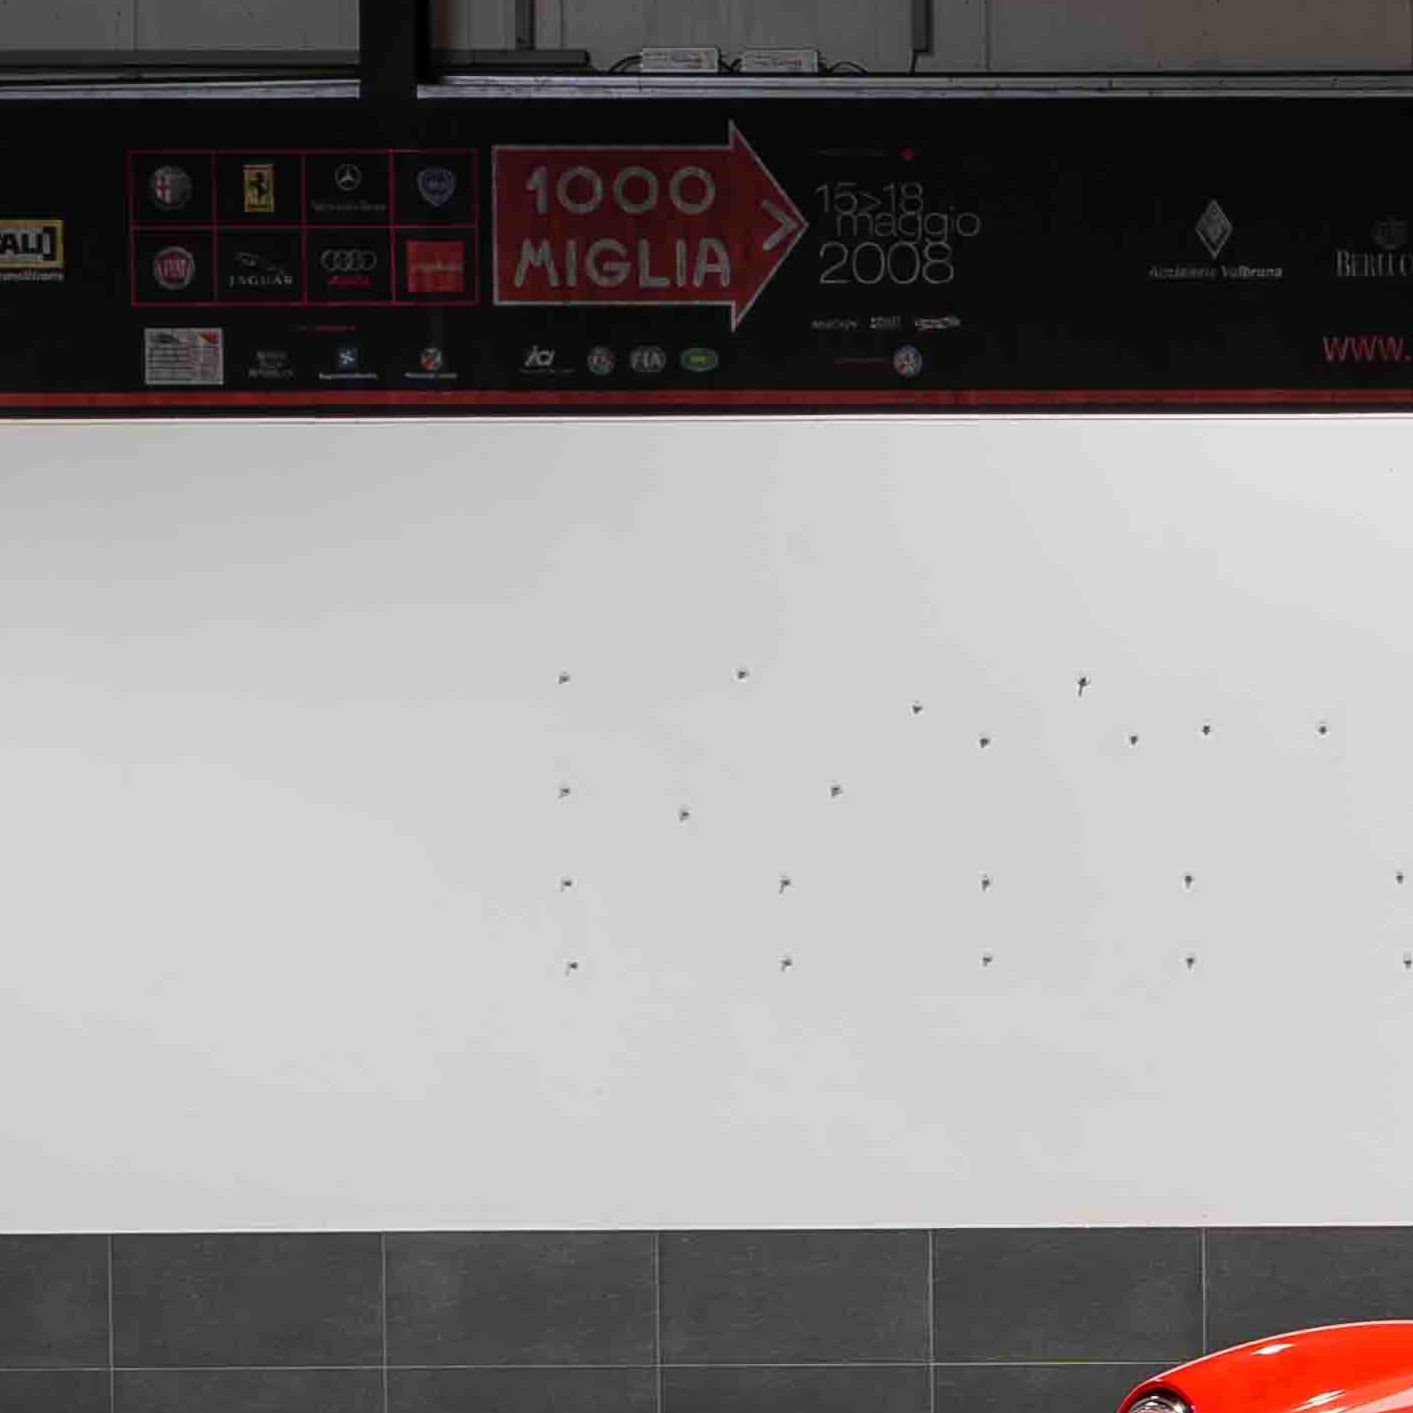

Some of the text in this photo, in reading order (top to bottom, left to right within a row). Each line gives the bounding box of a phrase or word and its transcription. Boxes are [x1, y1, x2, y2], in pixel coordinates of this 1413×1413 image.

[525, 165, 716, 216] 1000
[836, 204, 982, 245] maggio
[513, 237, 731, 289] MIGLIA
[819, 241, 957, 285] 2008
